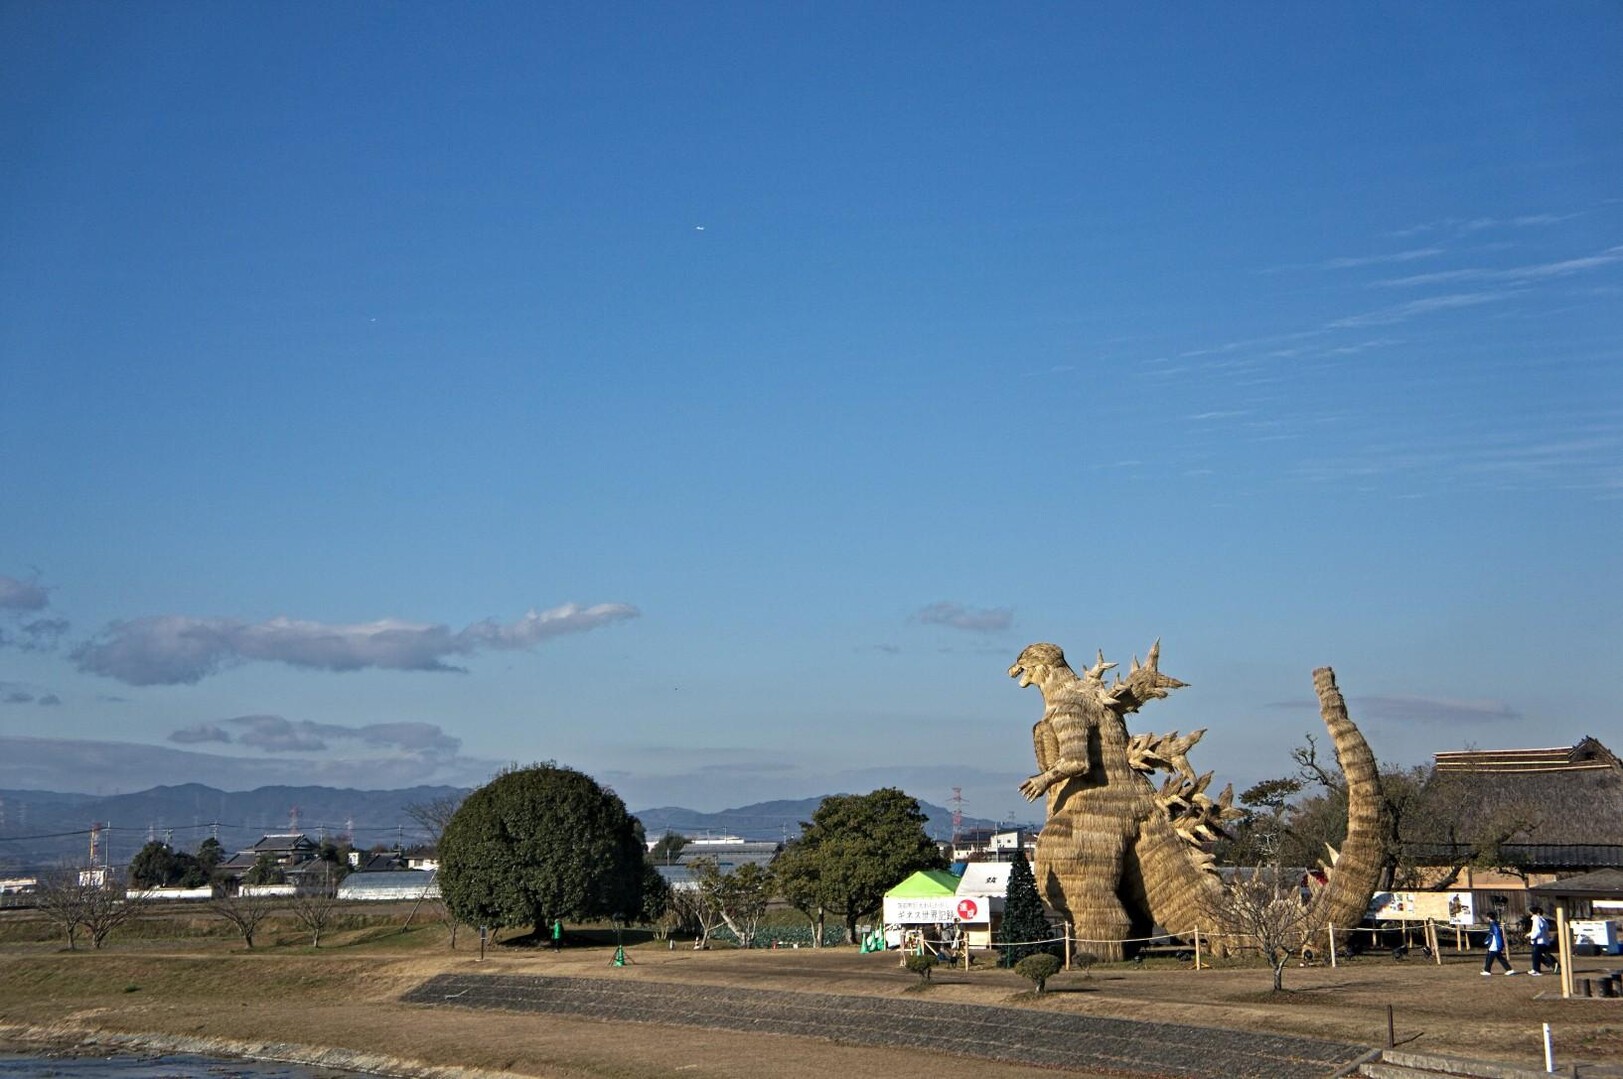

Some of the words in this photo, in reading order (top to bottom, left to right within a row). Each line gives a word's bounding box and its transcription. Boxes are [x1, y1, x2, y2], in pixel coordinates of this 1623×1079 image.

[897, 910, 954, 921] ギネス世界記録
